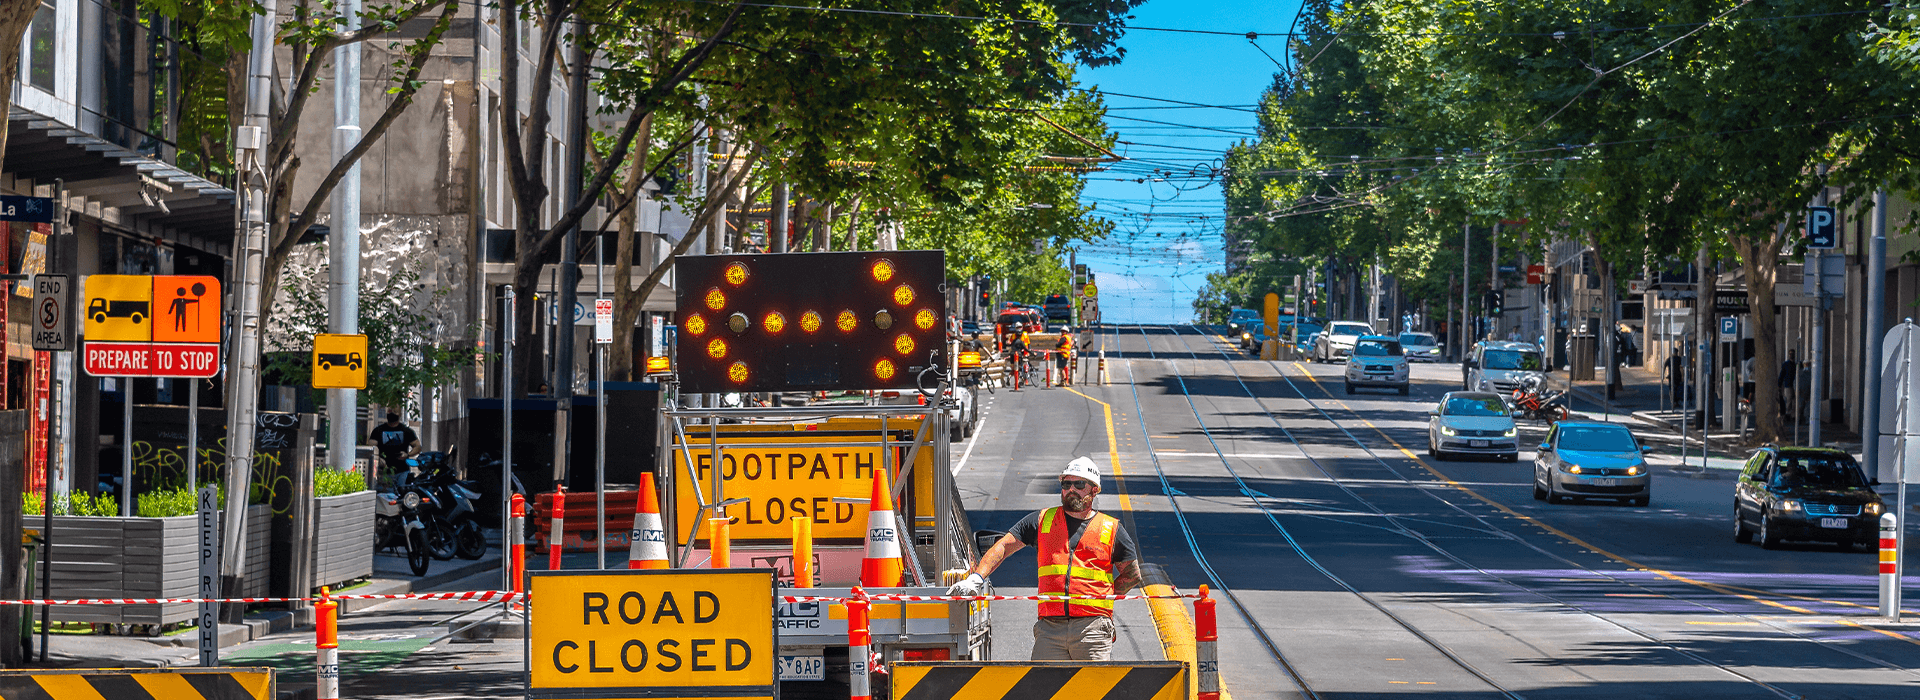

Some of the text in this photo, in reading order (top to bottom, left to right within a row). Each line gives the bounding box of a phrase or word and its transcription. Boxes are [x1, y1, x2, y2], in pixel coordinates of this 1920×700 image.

[0, 201, 16, 216] La
[1813, 210, 1832, 234] P
[40, 282, 60, 294] END
[1725, 321, 1733, 331] P
[36, 332, 62, 344] AREA
[89, 350, 214, 370] PREPARE TO STOP
[697, 453, 874, 480] FOOTPATH
[723, 498, 854, 525] CLOSED
[202, 491, 212, 565] KEEP
[870, 529, 893, 538] MC
[583, 591, 720, 625] ROAD
[203, 576, 212, 667] RIGHT
[553, 639, 752, 673] CLOSED
[796, 660, 821, 675] 8AP
